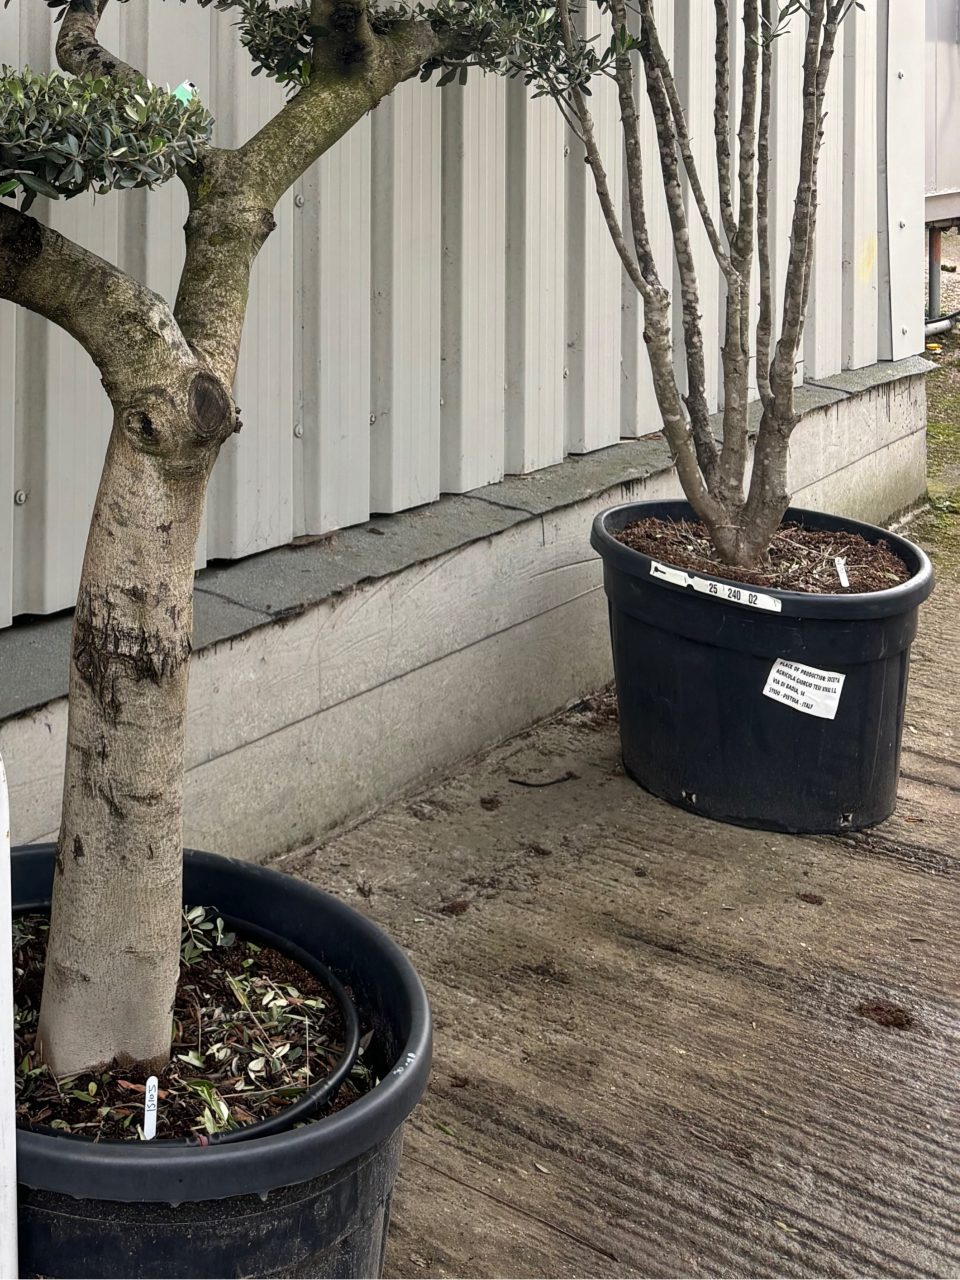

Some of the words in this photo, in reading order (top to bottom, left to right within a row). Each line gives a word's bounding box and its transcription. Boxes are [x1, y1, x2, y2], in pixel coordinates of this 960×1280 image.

[709, 583, 718, 594] 25
[727, 588, 741, 600] 240
[748, 593, 758, 604] 02
[780, 661, 793, 670] PLACE
[802, 701, 813, 709] ITALY
